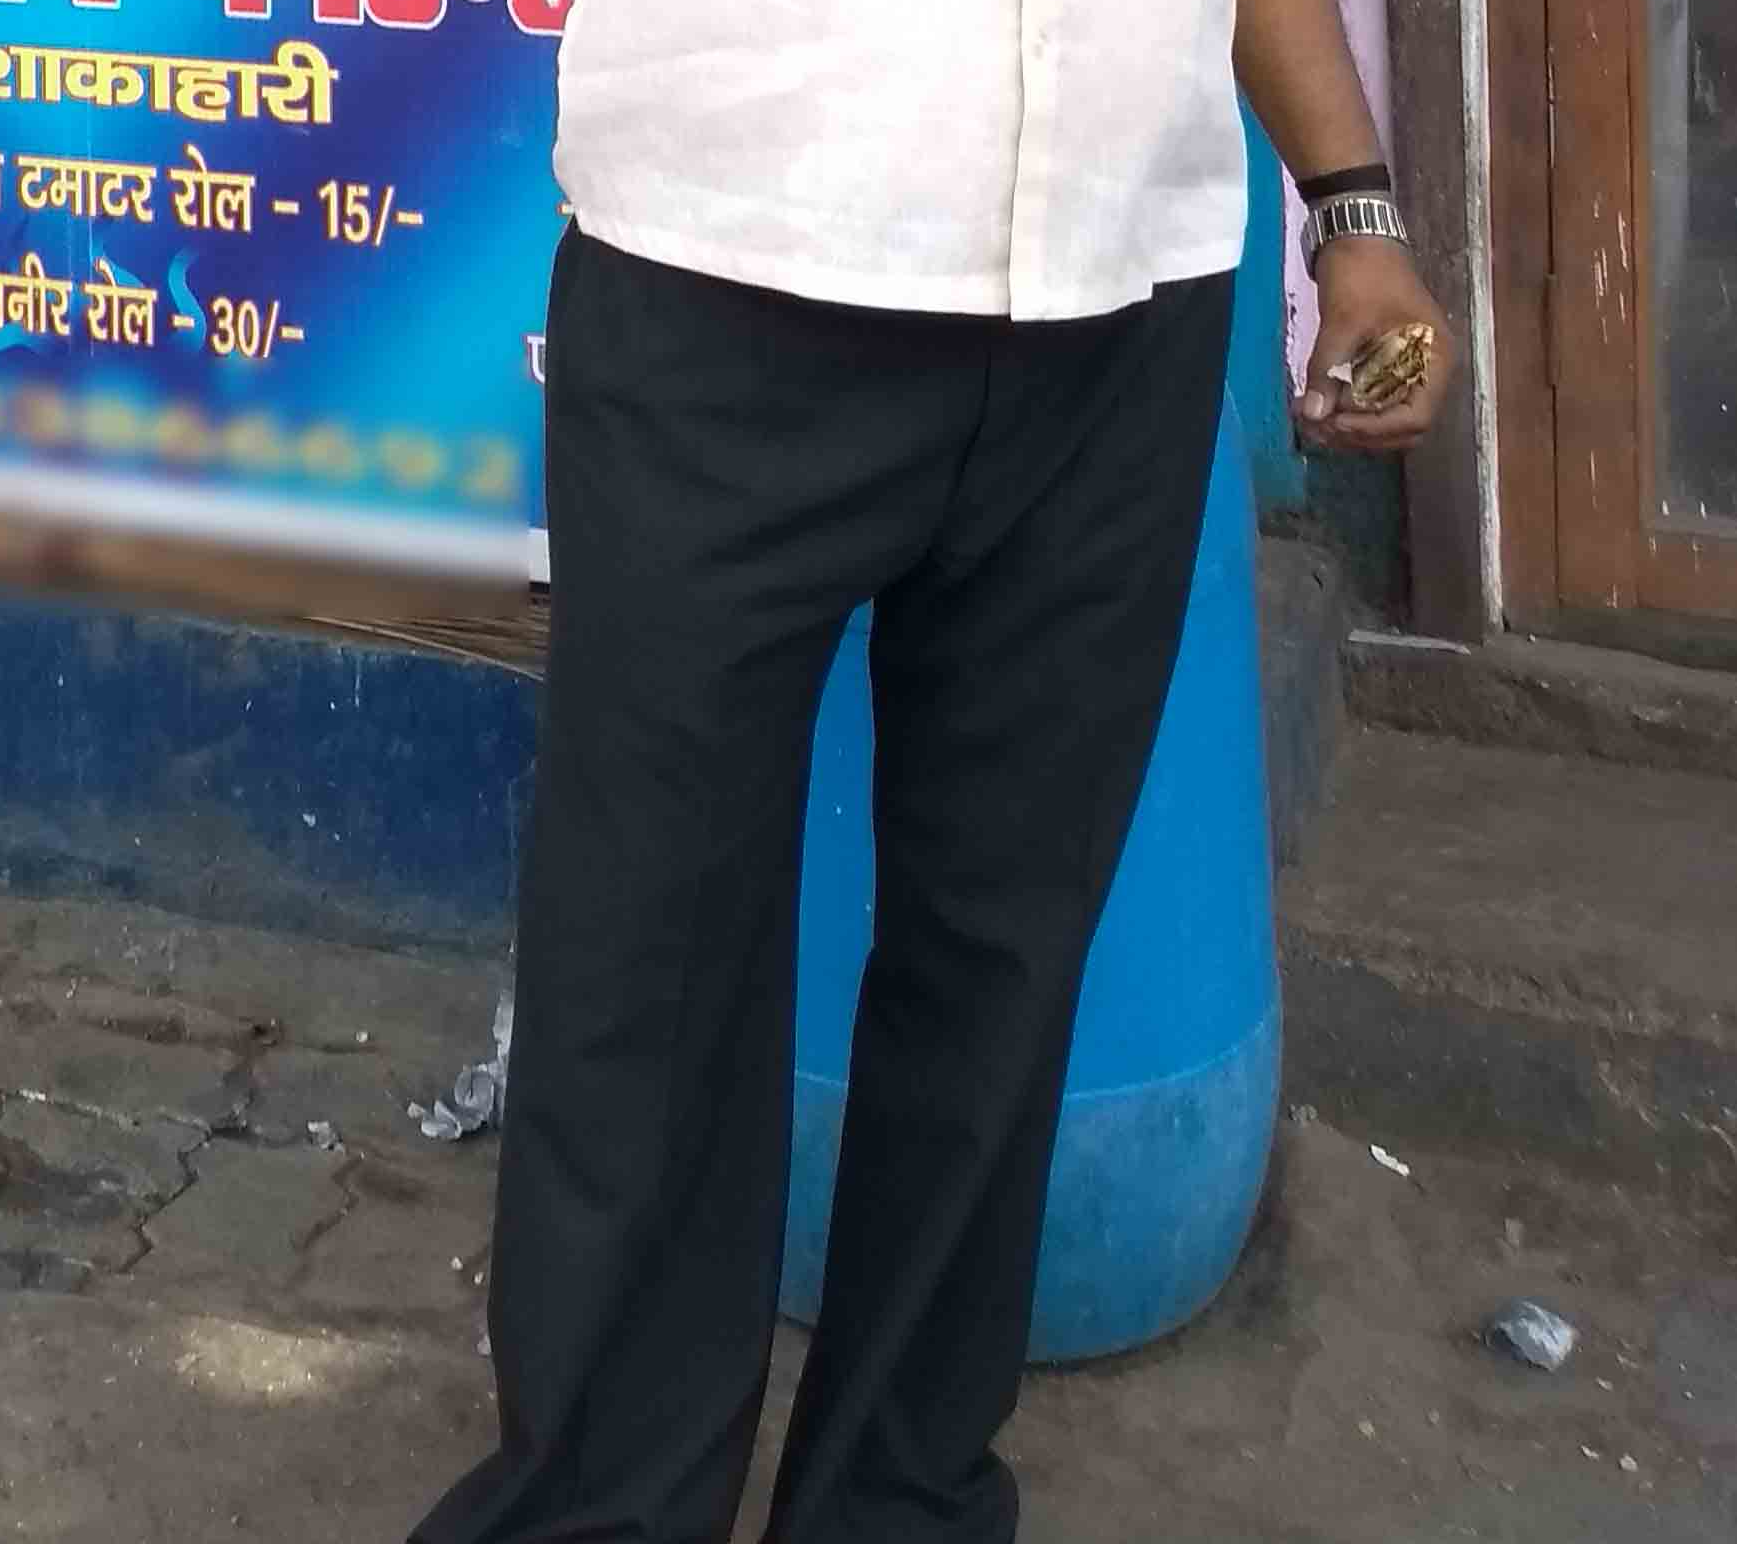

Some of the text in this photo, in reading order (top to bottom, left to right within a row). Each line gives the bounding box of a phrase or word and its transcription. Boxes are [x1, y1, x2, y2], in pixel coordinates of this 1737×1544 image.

[17, 151, 158, 225] टमाटर
[167, 143, 256, 234] रोल
[317, 178, 426, 249] 15/-
[83, 259, 158, 348] रोल
[209, 295, 306, 361] 30/-
